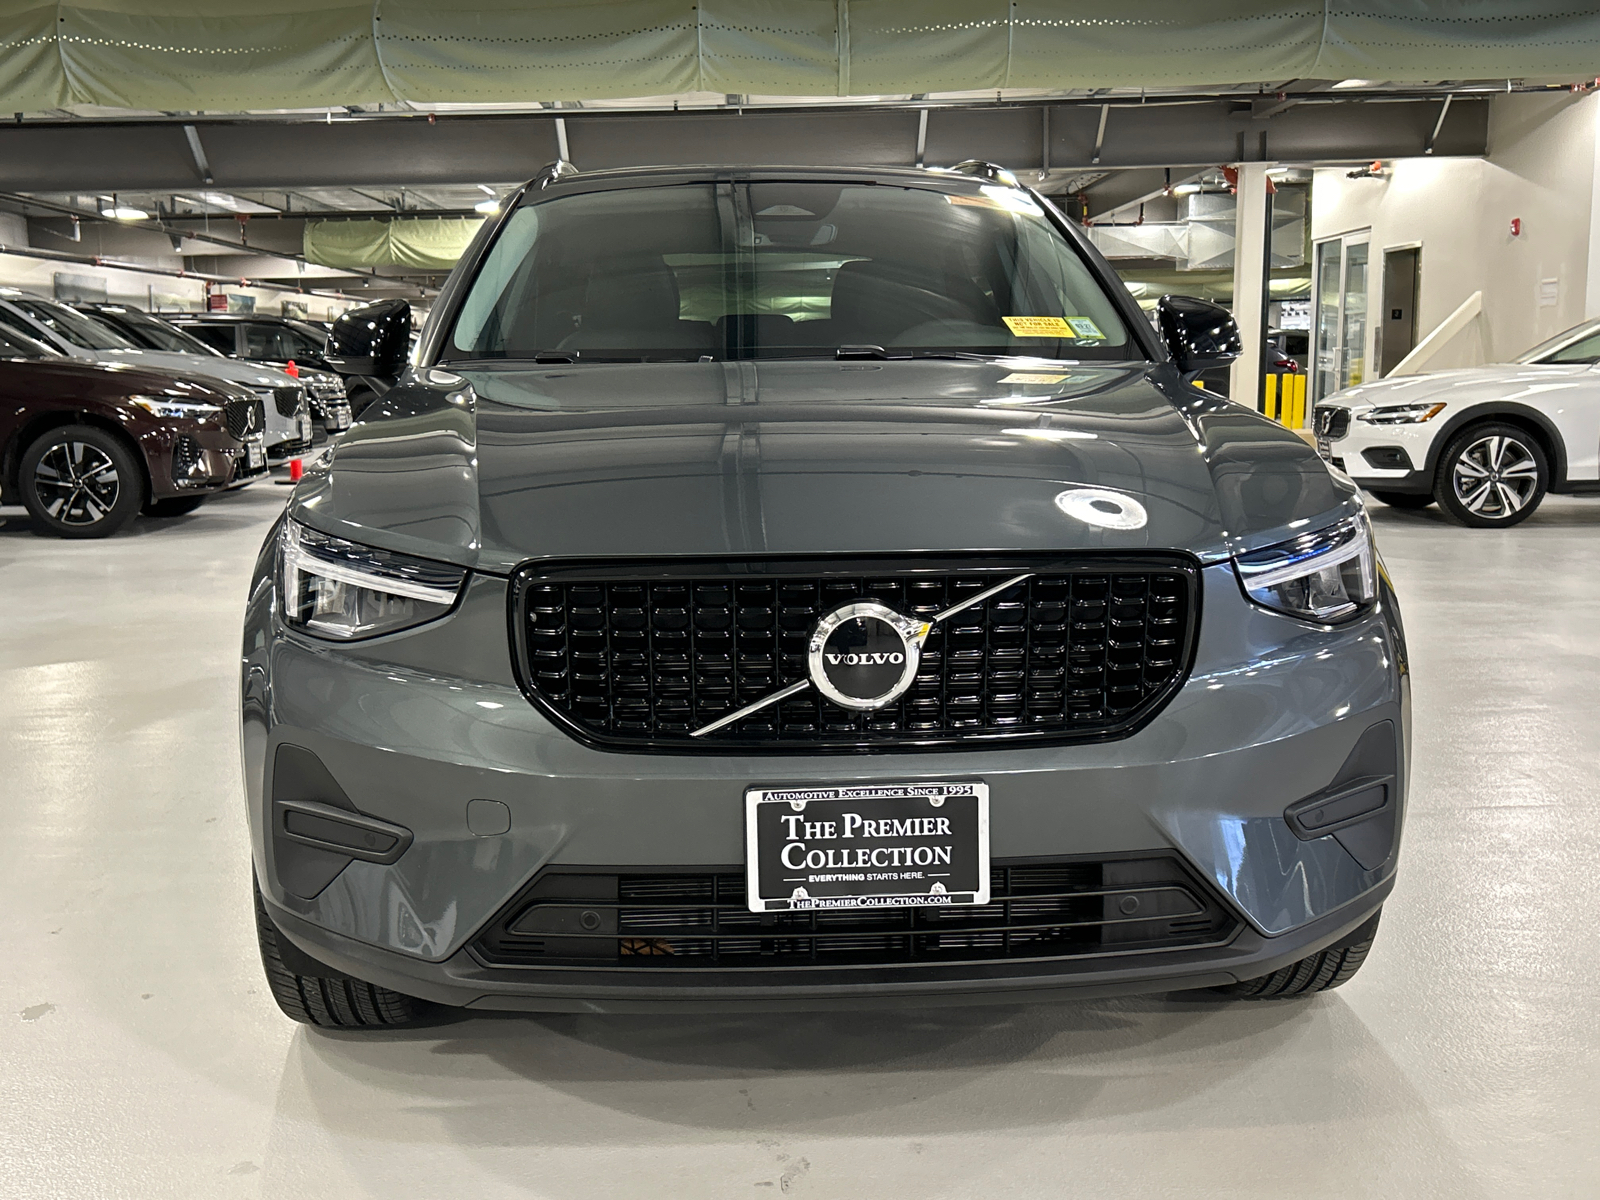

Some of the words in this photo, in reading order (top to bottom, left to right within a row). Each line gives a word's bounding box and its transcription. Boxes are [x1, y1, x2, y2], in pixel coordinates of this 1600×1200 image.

[825, 652, 904, 665] VOLVO
[942, 785, 973, 796] 1995
[780, 814, 837, 840] THE
[841, 813, 953, 838] PREMIER
[780, 842, 953, 870] COLLECTION
[808, 873, 865, 883] EVERYTHING
[866, 872, 899, 881] STARTS
[899, 871, 926, 880] HERE.
